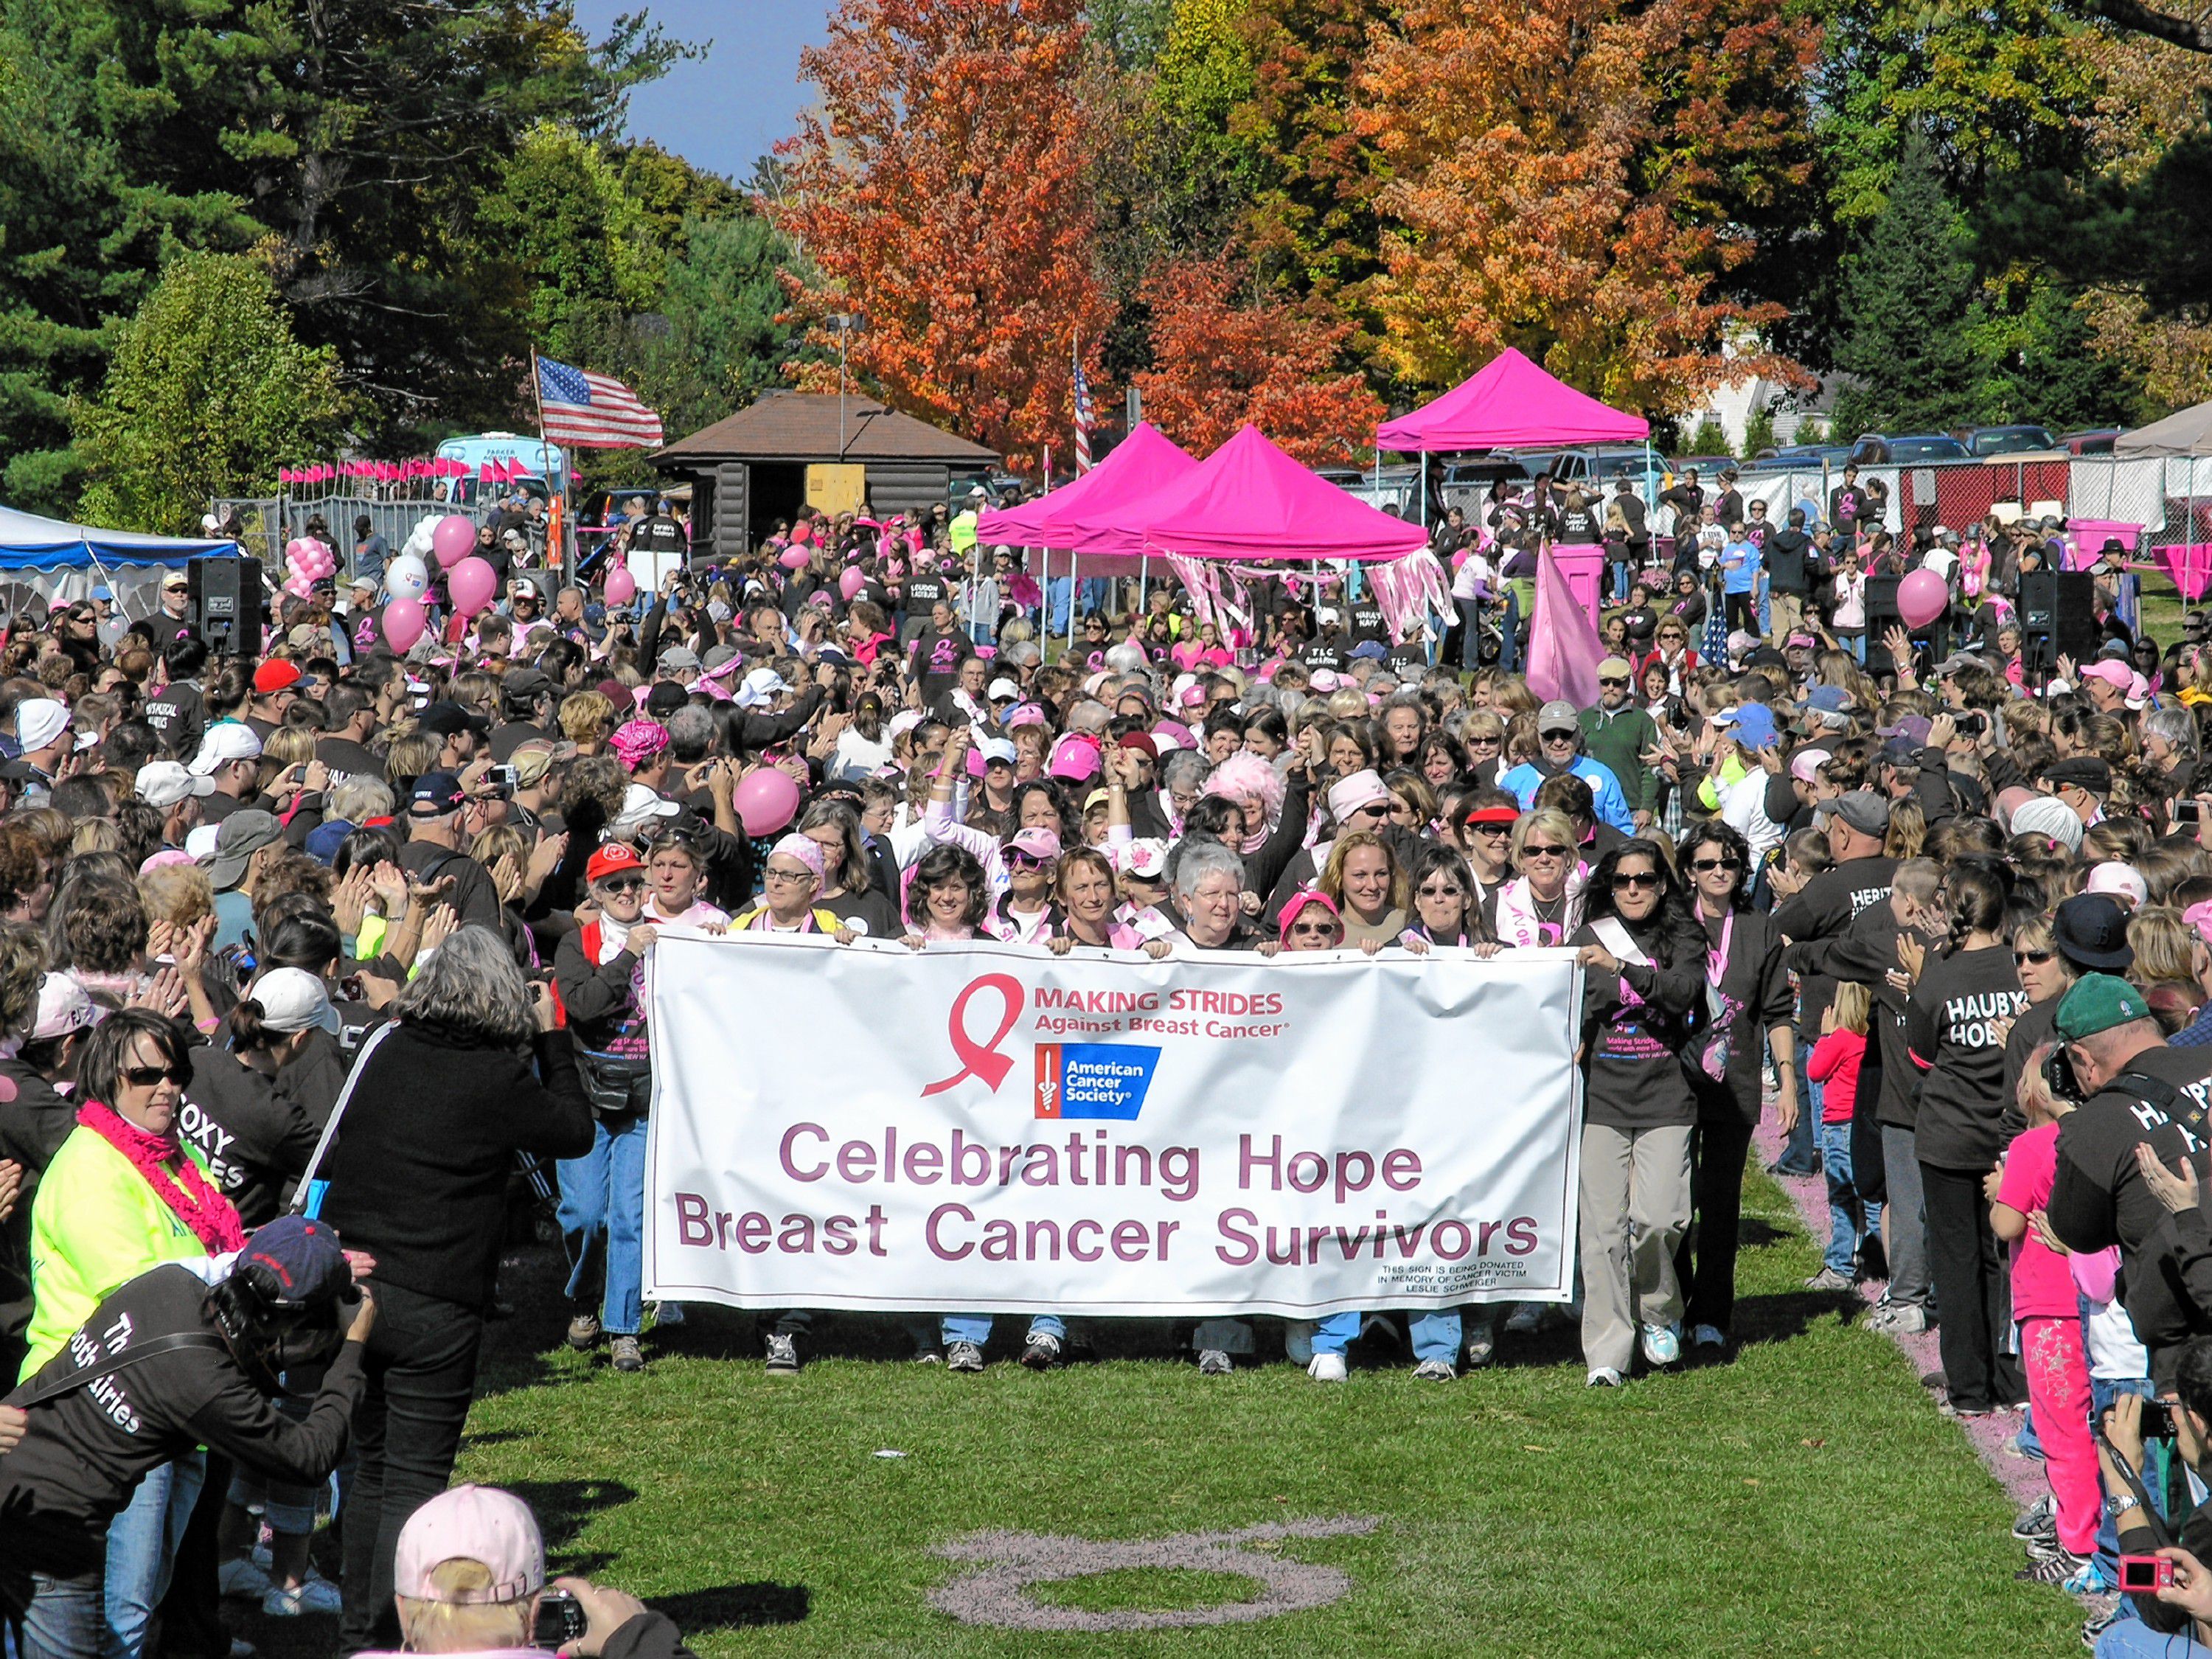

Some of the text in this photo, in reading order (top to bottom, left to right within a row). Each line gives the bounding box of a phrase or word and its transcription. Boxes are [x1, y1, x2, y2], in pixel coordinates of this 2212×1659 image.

[1312, 648, 1334, 656] TLC
[1034, 988, 1283, 1016] MAKING STRIDES
[1034, 1014, 1123, 1035] Against
[1129, 1017, 1199, 1037] Breast
[1066, 1060, 1143, 1077] American
[1066, 1075, 1122, 1089] Cancer
[180, 1093, 236, 1157] OXY
[780, 1121, 1422, 1204] Celebrating Hope
[675, 1192, 1539, 1266] Breast Cancer Survivors
[1377, 1276, 1388, 1284] IN
[1391, 1276, 1434, 1284] MEMORY
[1437, 1276, 1451, 1284] OF
[1455, 1270, 1491, 1282] CANCER
[1382, 1261, 1524, 1274] THIS SIGN IS BEING DONATED
[103, 1312, 133, 1355] Th
